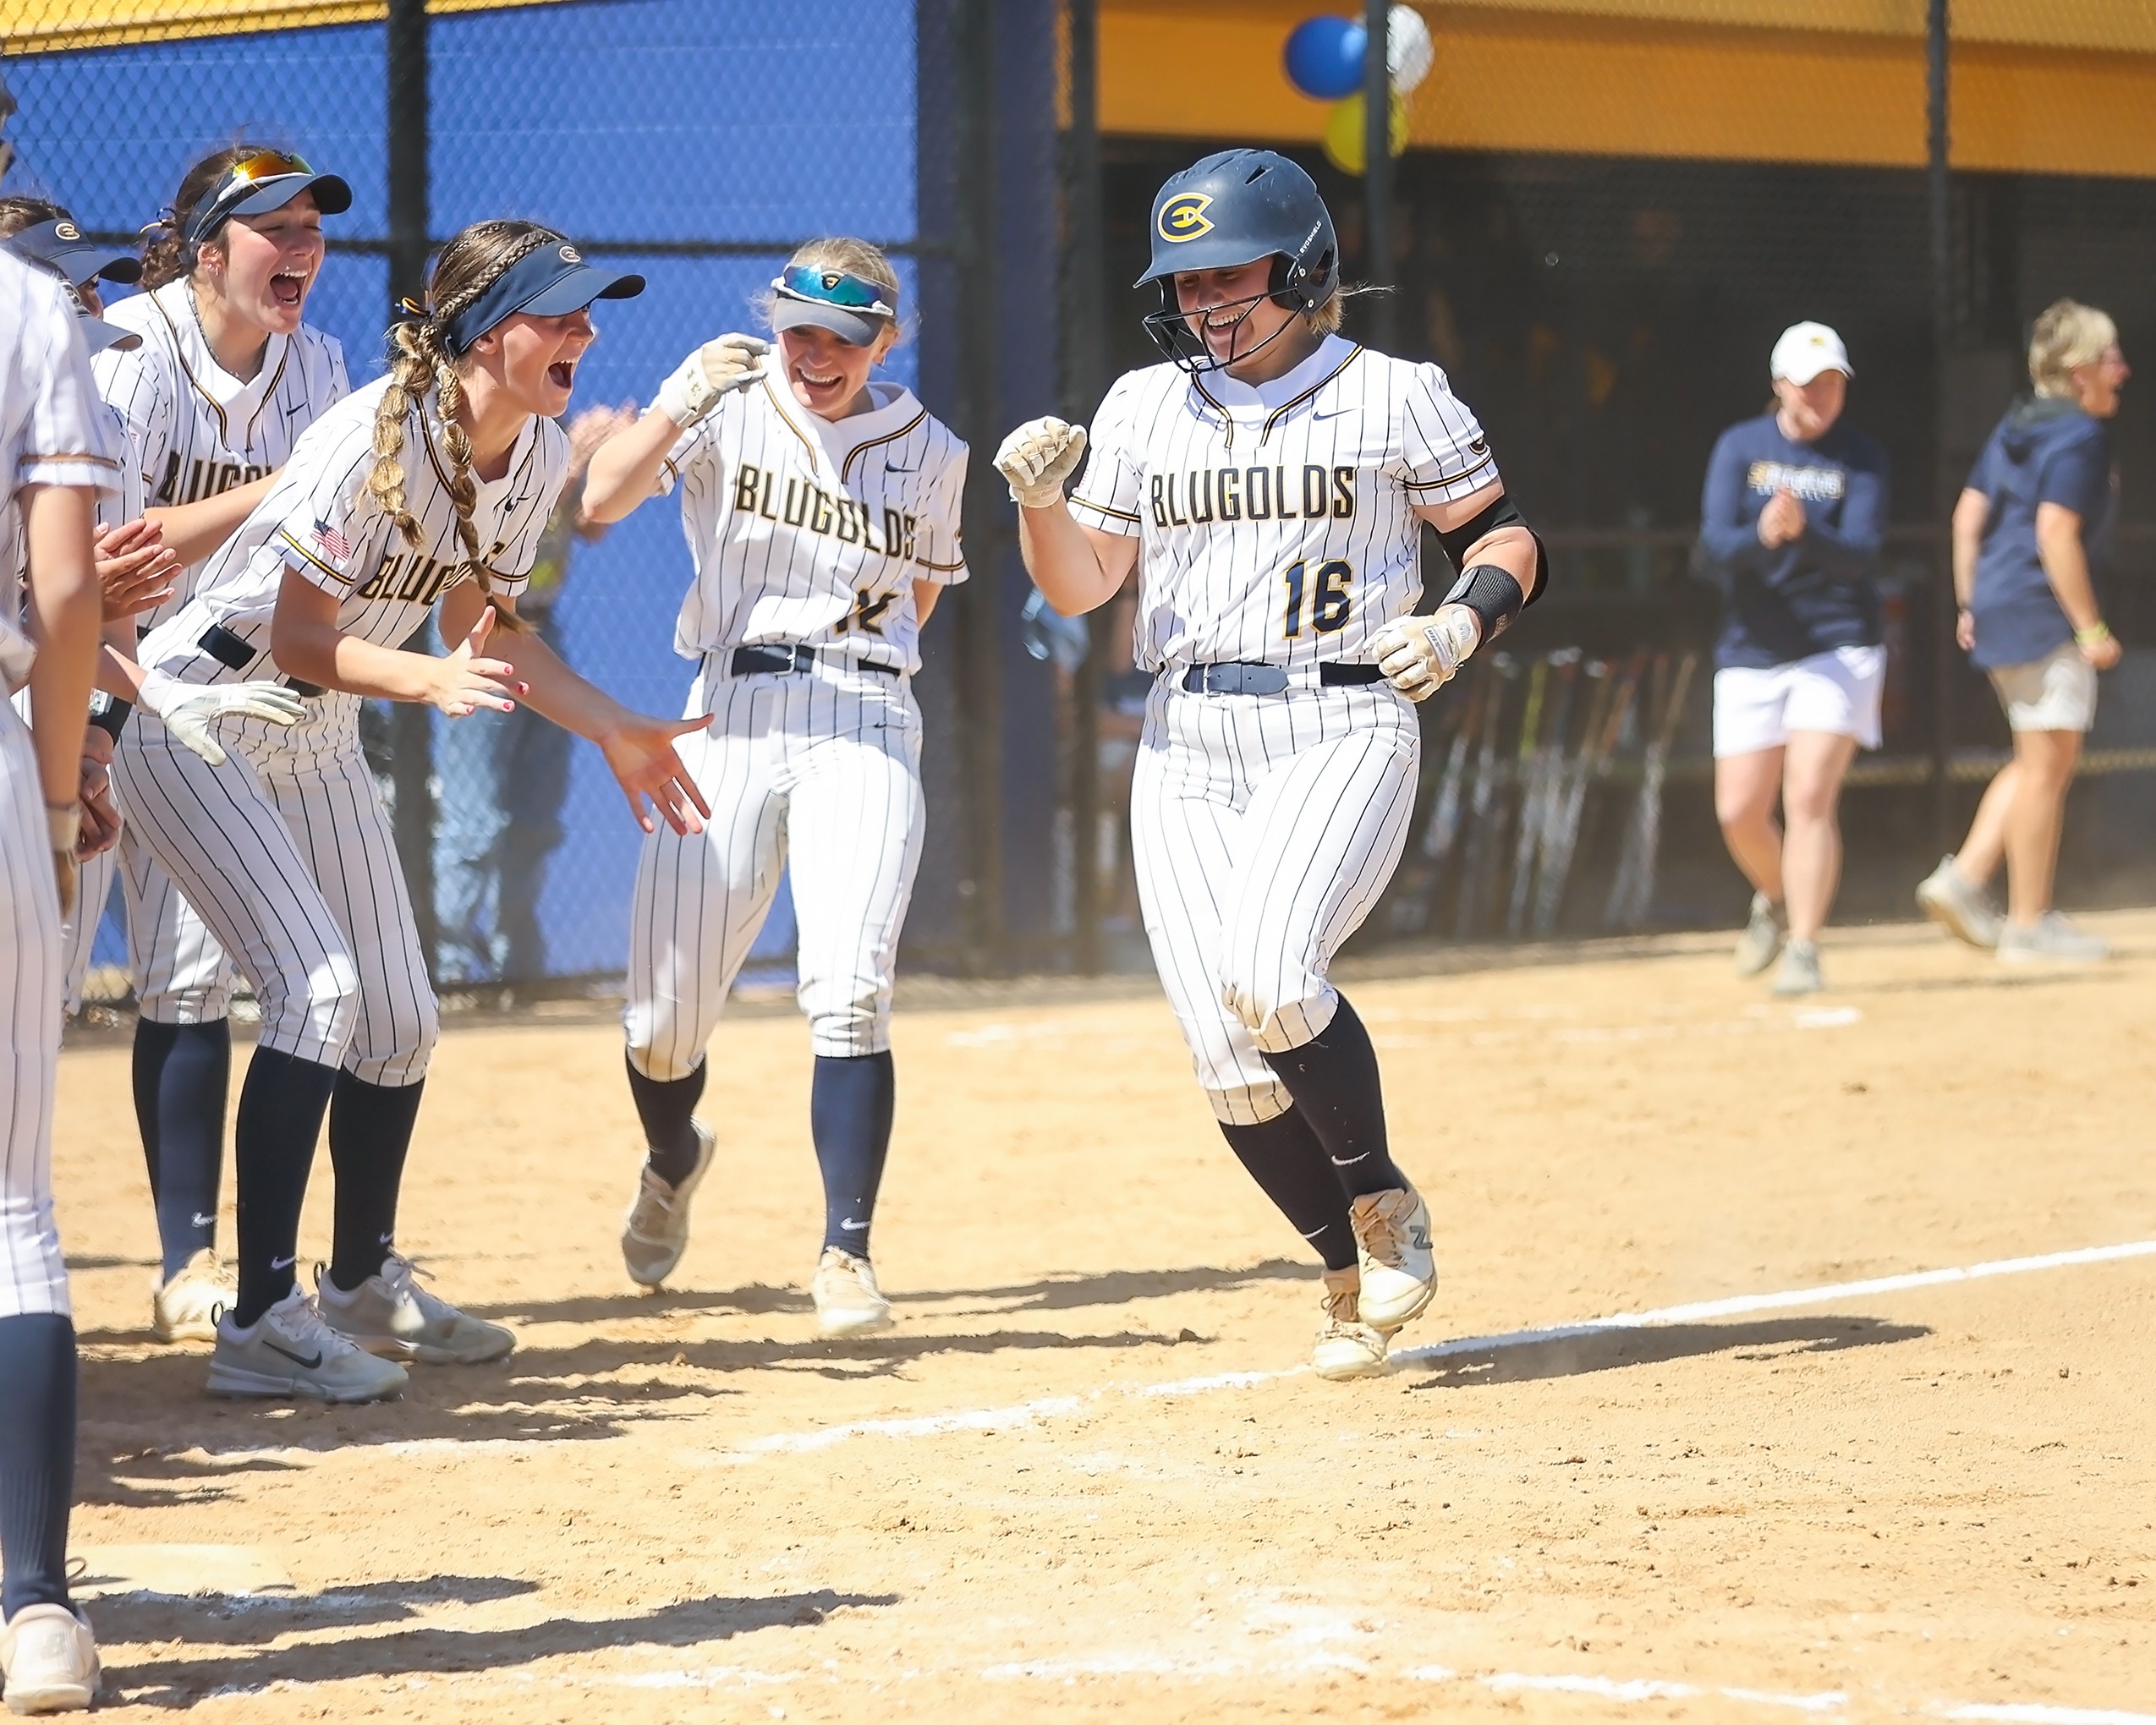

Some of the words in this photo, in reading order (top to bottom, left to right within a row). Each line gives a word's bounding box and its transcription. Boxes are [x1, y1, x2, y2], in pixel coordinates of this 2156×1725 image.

[735, 463, 916, 561] BLUGOLDS
[1150, 464, 1355, 528] BLUGOLDS
[1281, 558, 1354, 640] 16
